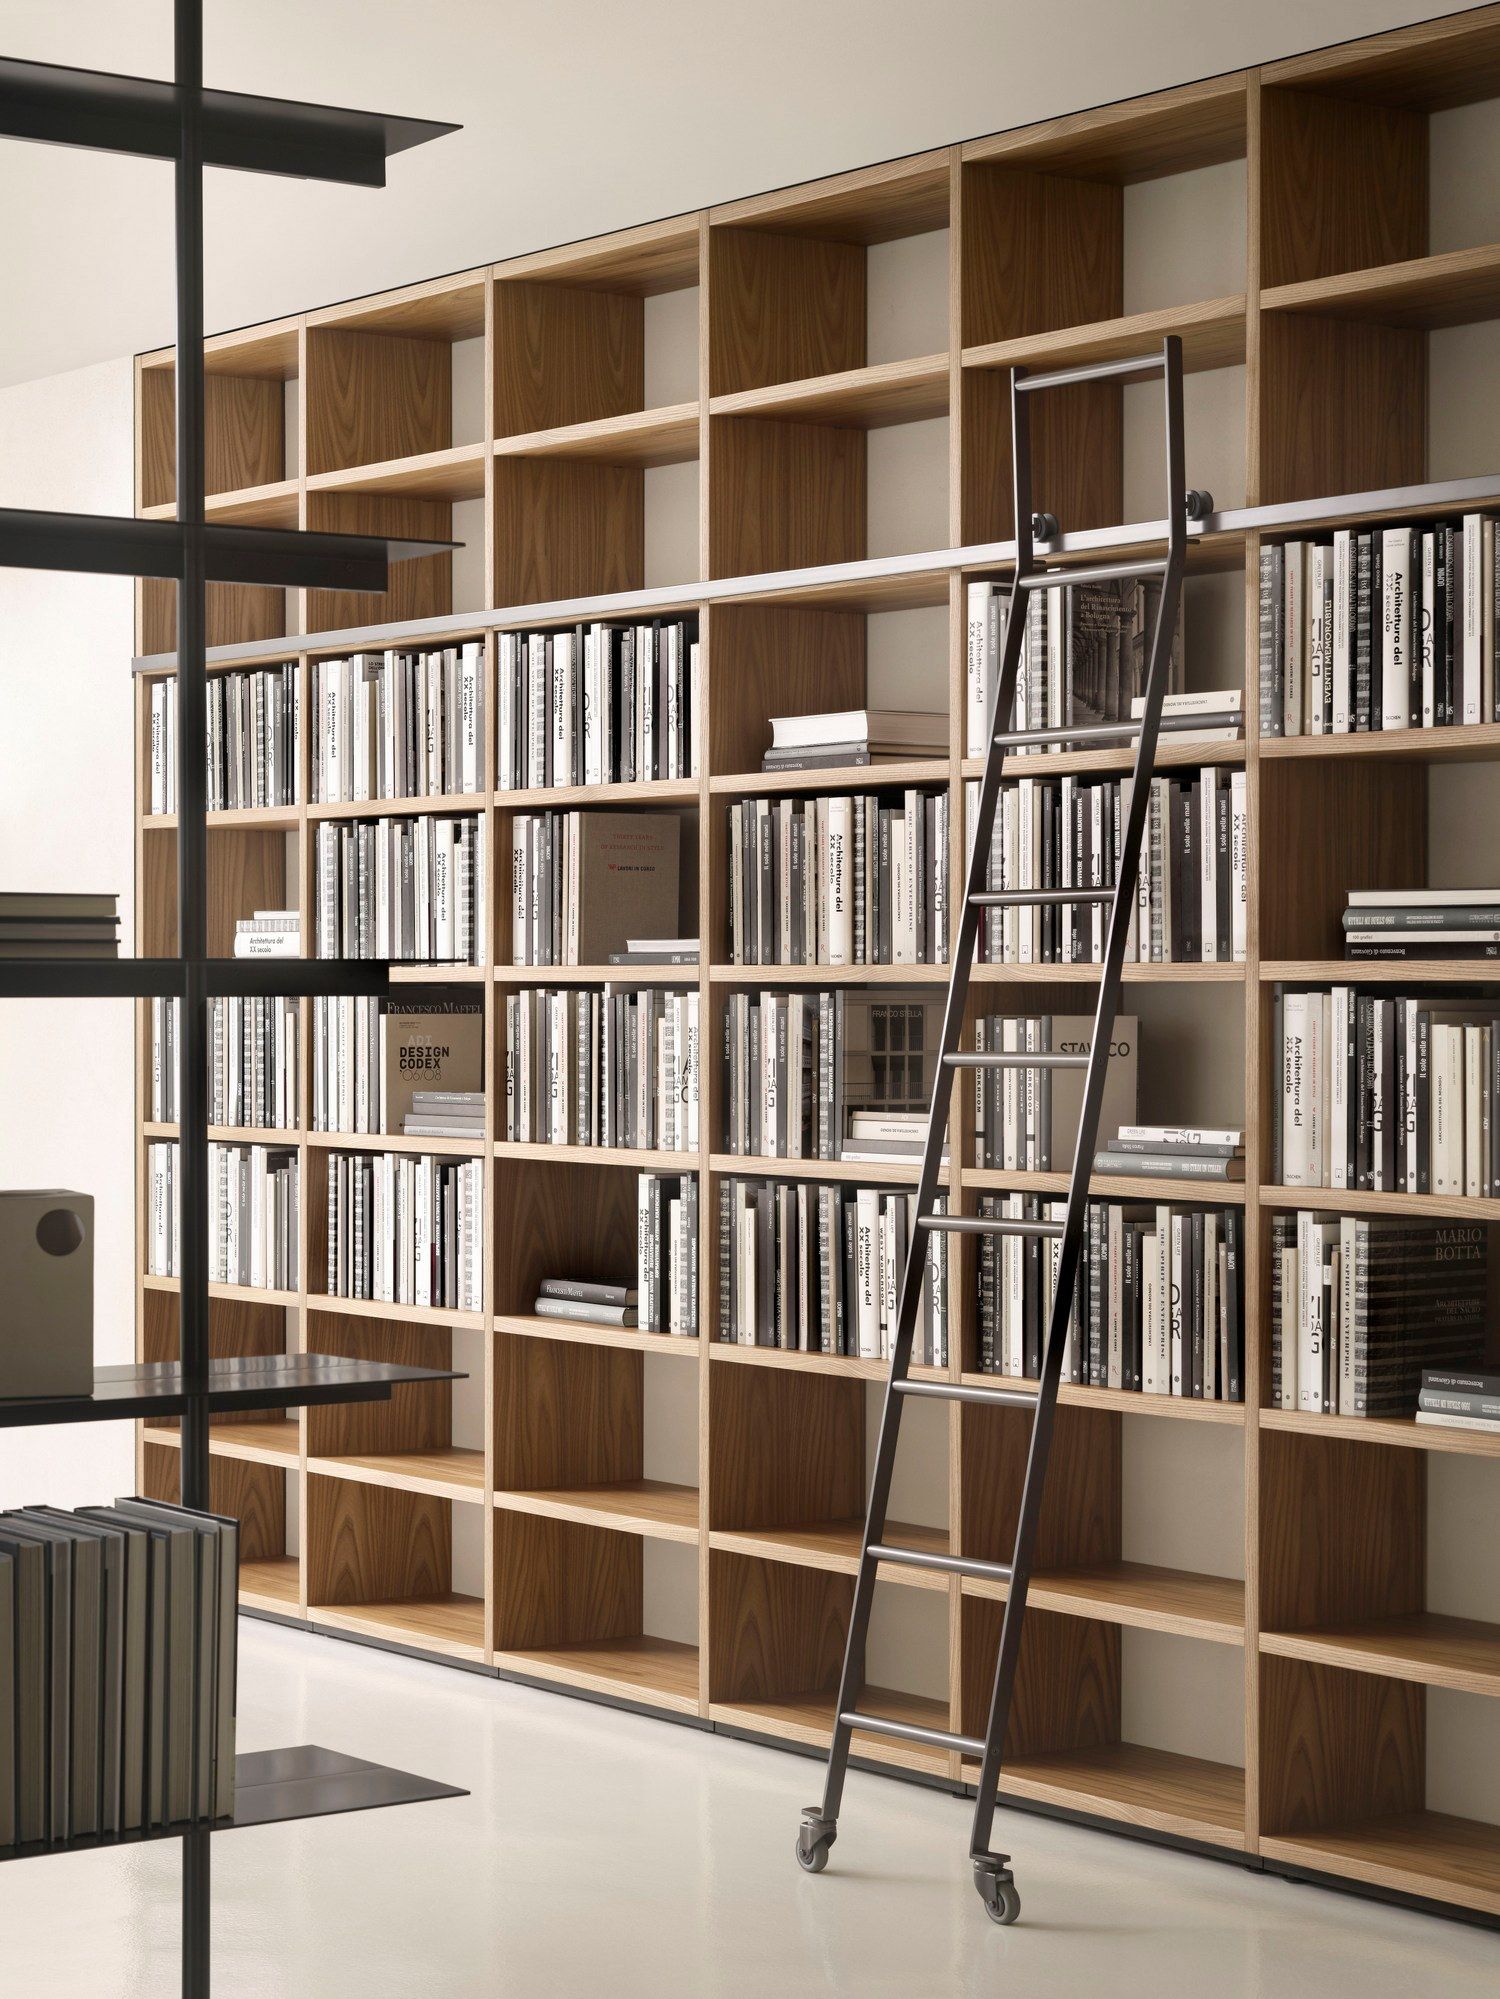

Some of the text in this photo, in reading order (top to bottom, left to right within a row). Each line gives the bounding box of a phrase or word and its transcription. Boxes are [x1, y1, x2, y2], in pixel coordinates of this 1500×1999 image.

[1386, 573, 1393, 591] XX
[1080, 594, 1120, 604] L'architettura
[1091, 604, 1132, 612] Rinascimento
[1085, 611, 1110, 620] Bologna
[1394, 572, 1403, 665] Architettura del
[969, 622, 974, 637] XX
[830, 834, 836, 849] XX
[250, 937, 275, 945] Architettura
[387, 1002, 481, 1014] FRANCESCO MAFFEI
[408, 1035, 432, 1046] ADI
[1286, 1037, 1293, 1053] XX
[400, 1047, 449, 1057] DESIGN
[400, 1058, 441, 1069] CODEX
[1294, 1036, 1302, 1126] Architettura del
[859, 1227, 864, 1242] XX
[1436, 1228, 1482, 1244] MARIO
[1053, 1243, 1059, 1259] XX
[1436, 1246, 1481, 1261] BOTTA
[1160, 1286, 1165, 1295] OF
[1345, 1301, 1350, 1314] OF
[1428, 1376, 1450, 1385] Giovanni
[1457, 1379, 1483, 1388] Benvenuto
